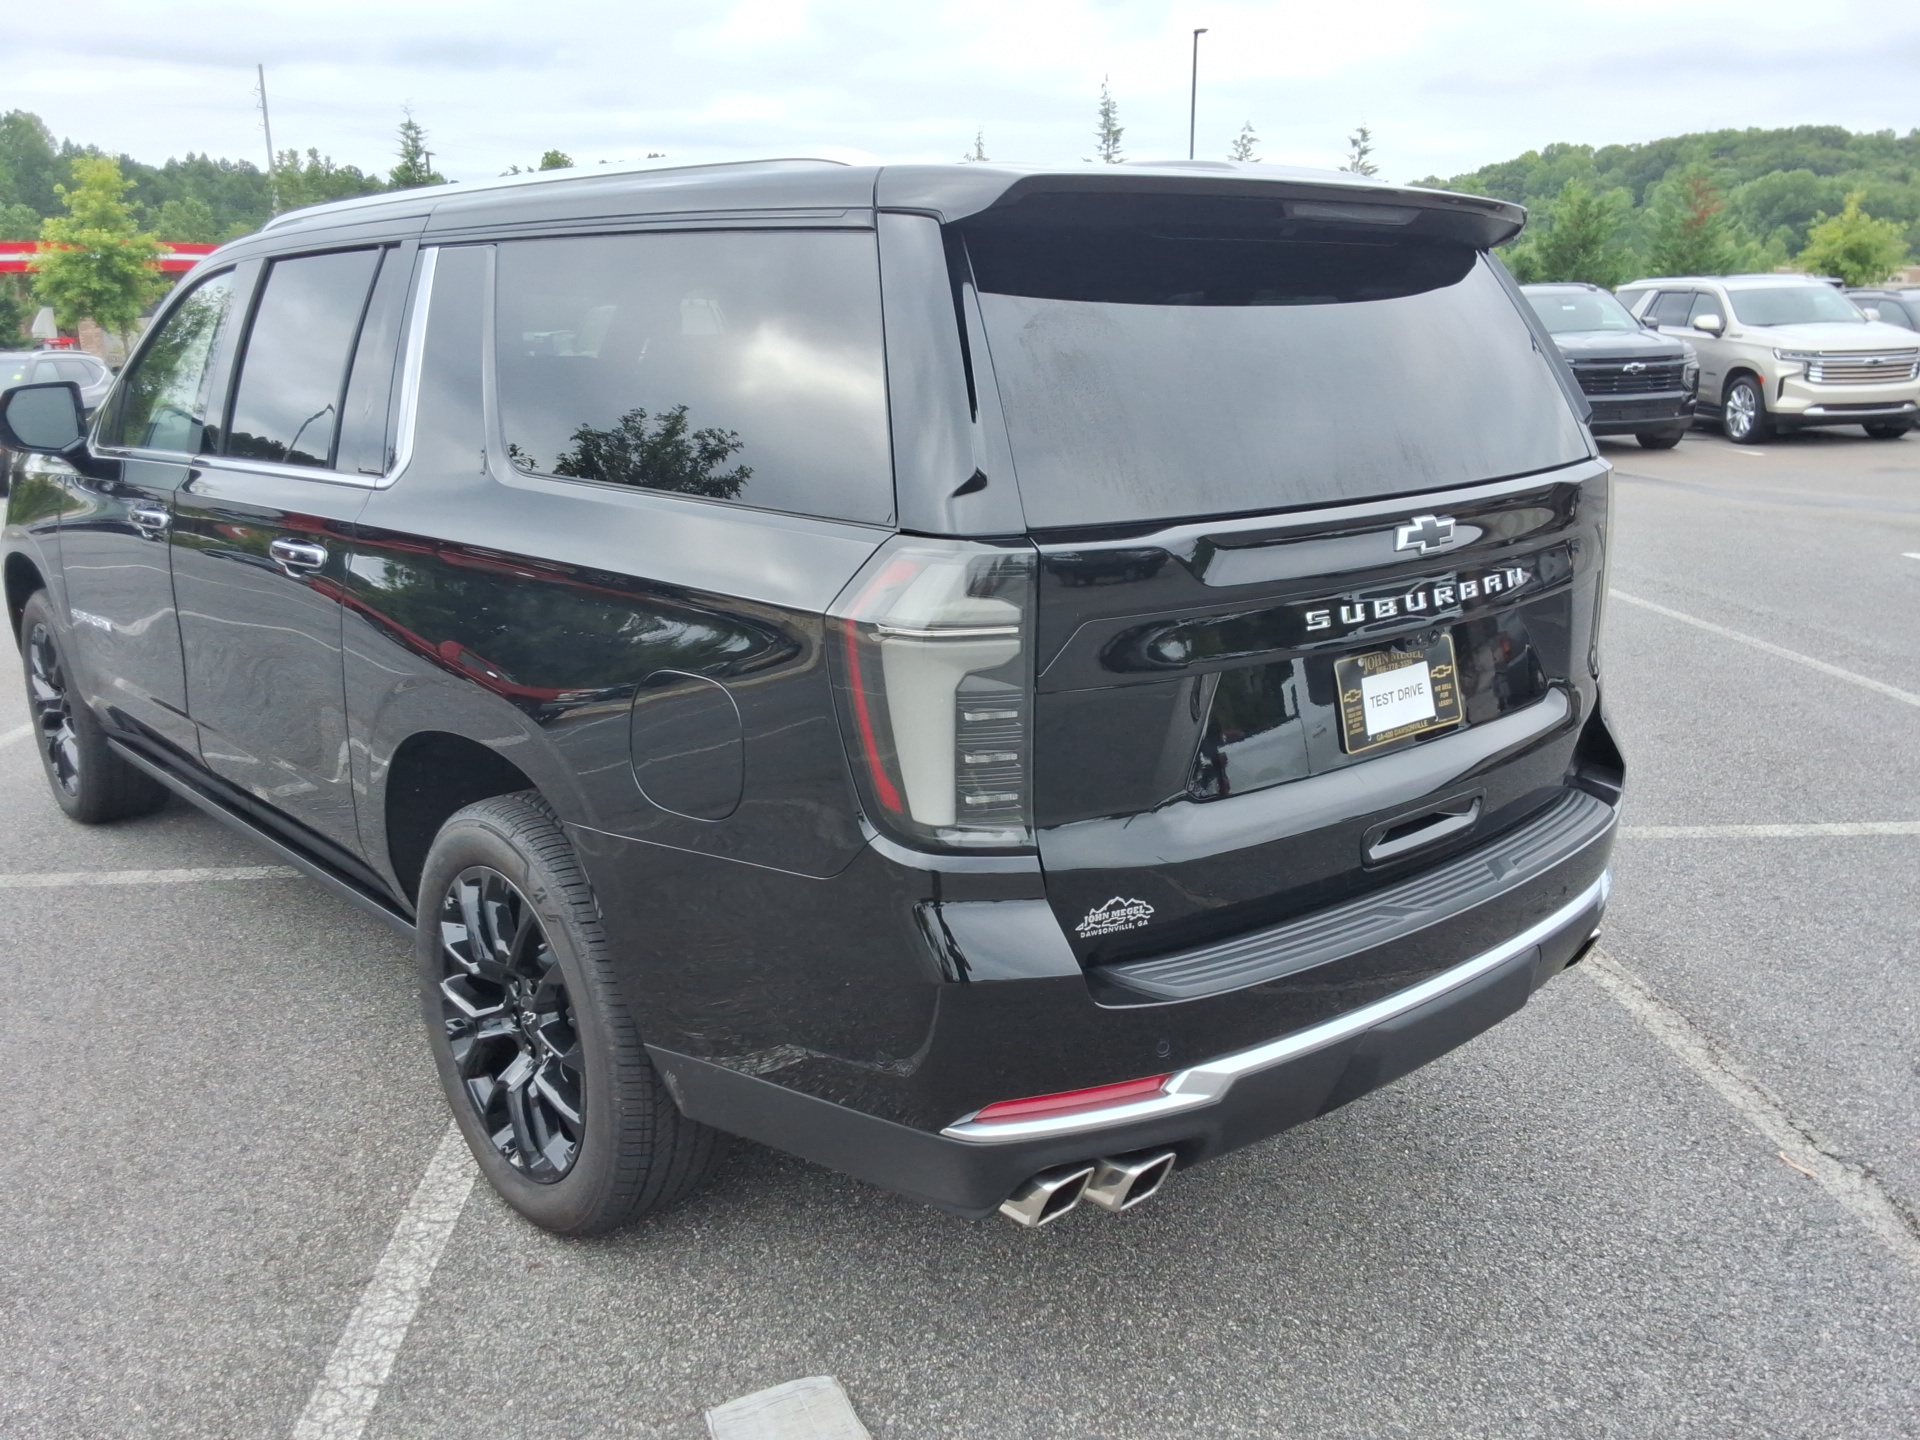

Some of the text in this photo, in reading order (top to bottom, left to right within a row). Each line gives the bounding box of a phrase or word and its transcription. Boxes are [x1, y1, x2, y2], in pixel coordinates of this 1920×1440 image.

[1306, 567, 1525, 631] SUBURBAN
[1363, 651, 1389, 676] JOHN
[1370, 691, 1395, 709] TEST
[1397, 683, 1425, 701] DRIVE
[1084, 905, 1145, 927] JOHN MEGEL
[1137, 919, 1149, 928] GA
